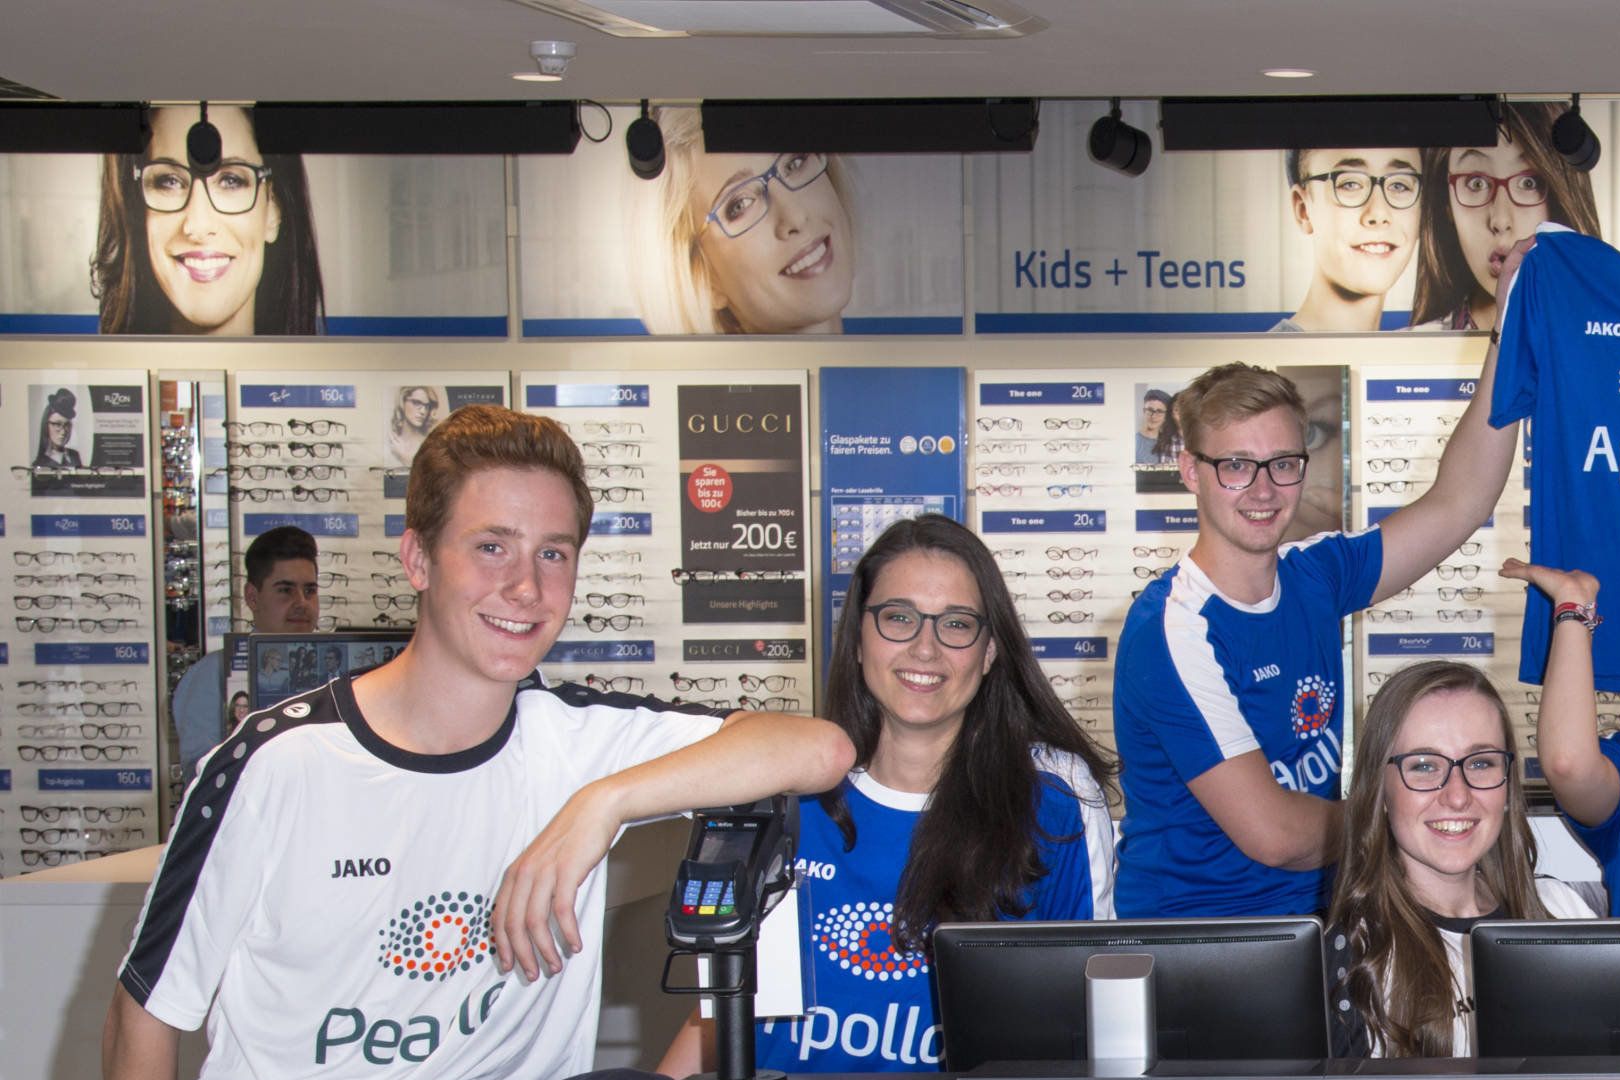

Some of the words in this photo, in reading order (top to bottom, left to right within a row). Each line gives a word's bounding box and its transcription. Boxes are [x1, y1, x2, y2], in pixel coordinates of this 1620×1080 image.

[1014, 249, 1092, 288] Kids
[1105, 258, 1128, 286] +
[1136, 250, 1246, 288] Teens
[319, 389, 344, 401] 160€
[611, 388, 638, 401] 200€
[1009, 390, 1025, 398] The
[1071, 385, 1093, 398] 20€
[1395, 385, 1412, 394] The
[687, 413, 793, 433] GUCCI
[830, 434, 879, 447] Glaspakete
[880, 436, 891, 444] zu
[830, 445, 856, 455] fairen
[858, 445, 893, 455] Preisen.
[703, 467, 717, 477] Sie
[695, 478, 725, 488] sparen
[698, 489, 711, 498] bis
[712, 490, 723, 498] zu
[111, 518, 134, 531] 160€
[324, 517, 346, 531] 160€
[613, 517, 640, 529] 200€
[1073, 513, 1094, 526] 20€
[1165, 516, 1181, 524] The
[690, 541, 712, 551] Jetzt
[709, 600, 737, 609] Unsere
[738, 600, 779, 611] Highlights
[1074, 641, 1096, 654] 40€
[1461, 636, 1482, 649] 70€
[115, 647, 138, 659] 160€
[616, 644, 643, 656] 200€
[1252, 663, 1281, 683] JAKO
[117, 772, 141, 785] 160€
[330, 857, 392, 879] JAKO
